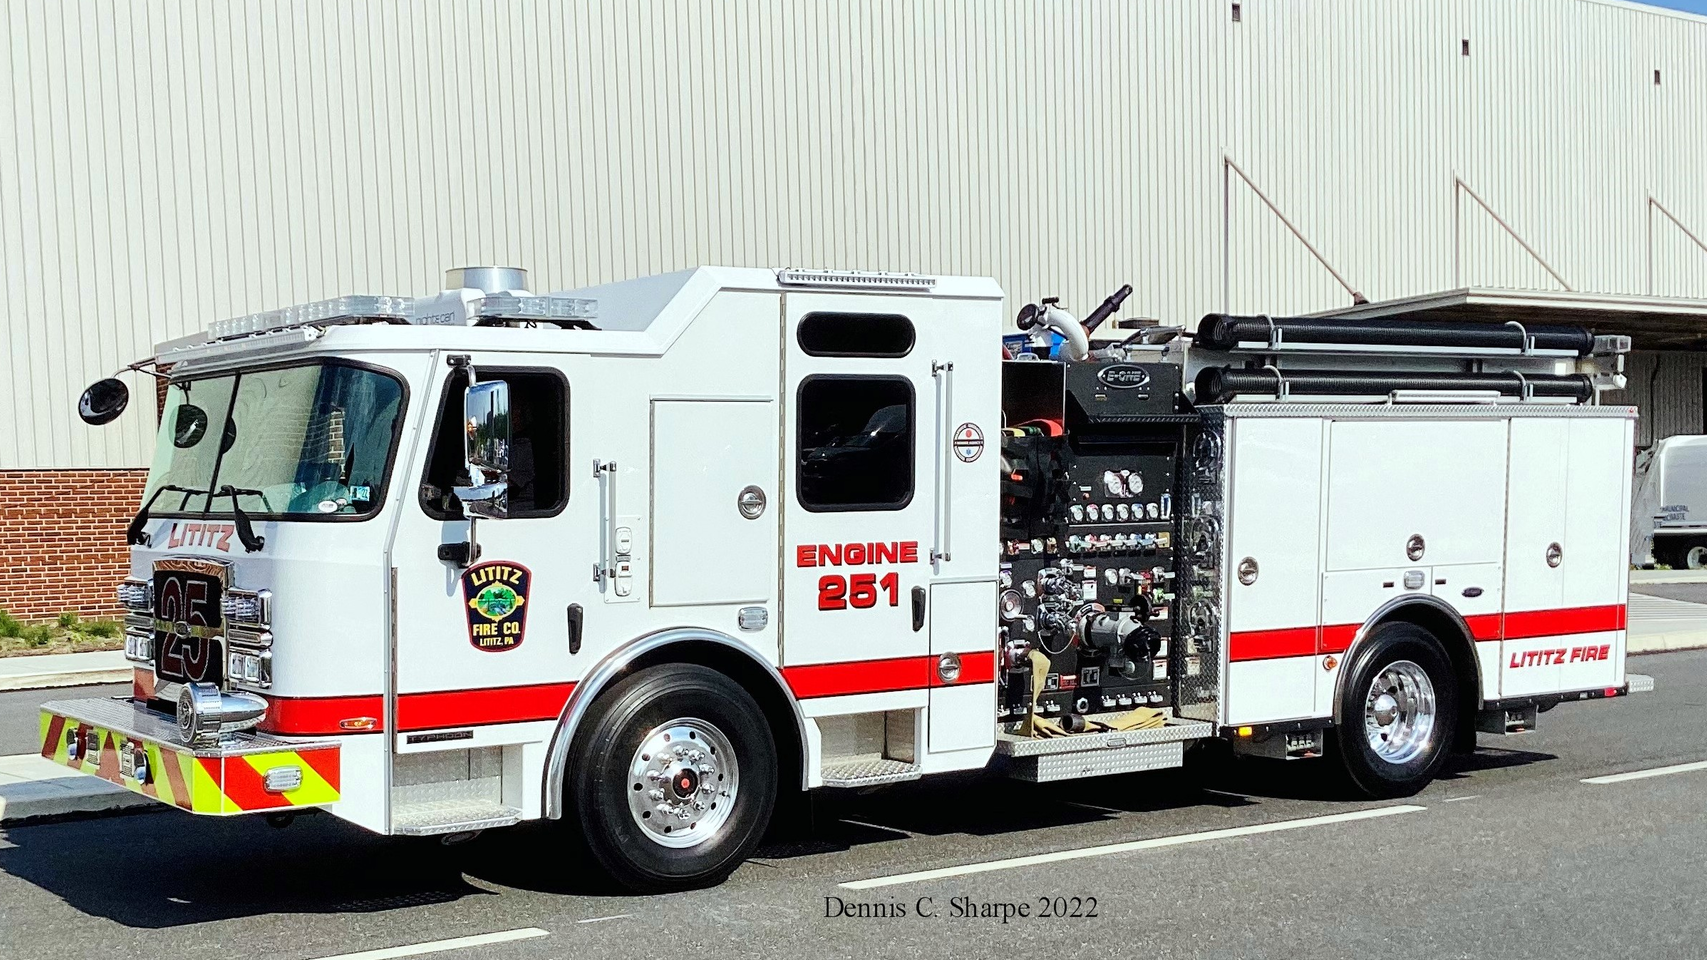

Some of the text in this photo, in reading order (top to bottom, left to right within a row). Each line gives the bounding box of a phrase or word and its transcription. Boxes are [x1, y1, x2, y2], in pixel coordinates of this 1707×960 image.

[168, 523, 235, 552] LITITZ
[796, 541, 918, 567] ENGINE
[471, 566, 522, 586] LITITZ
[818, 572, 899, 611] 251
[473, 621, 521, 636] FIRE CO.
[504, 636, 514, 645] PA
[1509, 644, 1611, 669] LITITZ FIRE
[408, 731, 473, 742] TYPHOON
